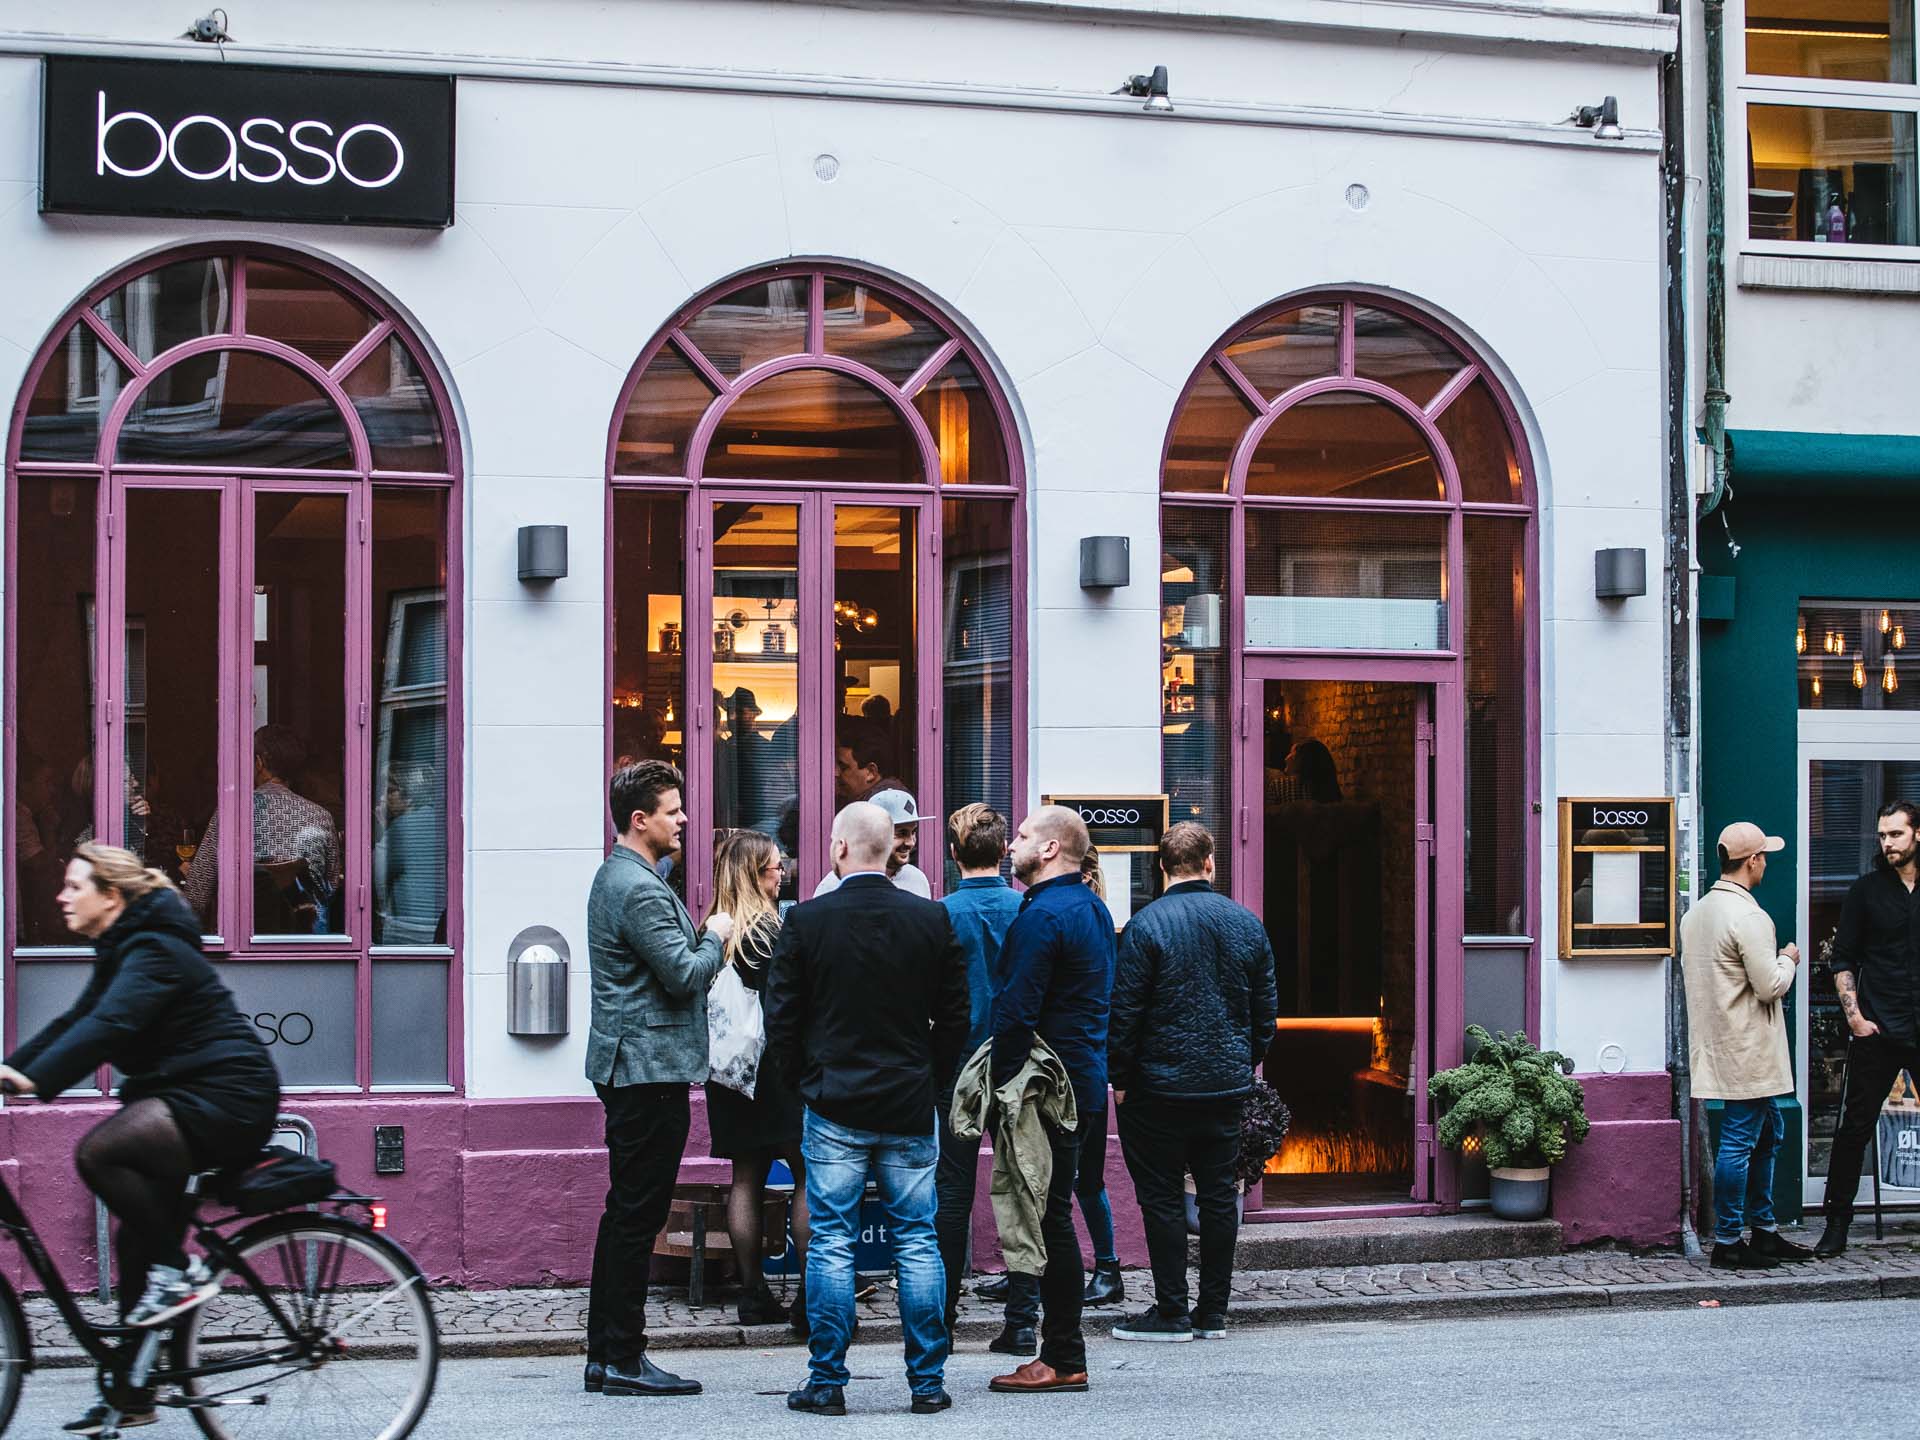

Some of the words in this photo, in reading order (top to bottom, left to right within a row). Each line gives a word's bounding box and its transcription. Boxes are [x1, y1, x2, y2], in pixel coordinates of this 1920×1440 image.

[97, 90, 404, 188] basso
[1079, 805, 1140, 824] basso
[1593, 807, 1649, 825] basso
